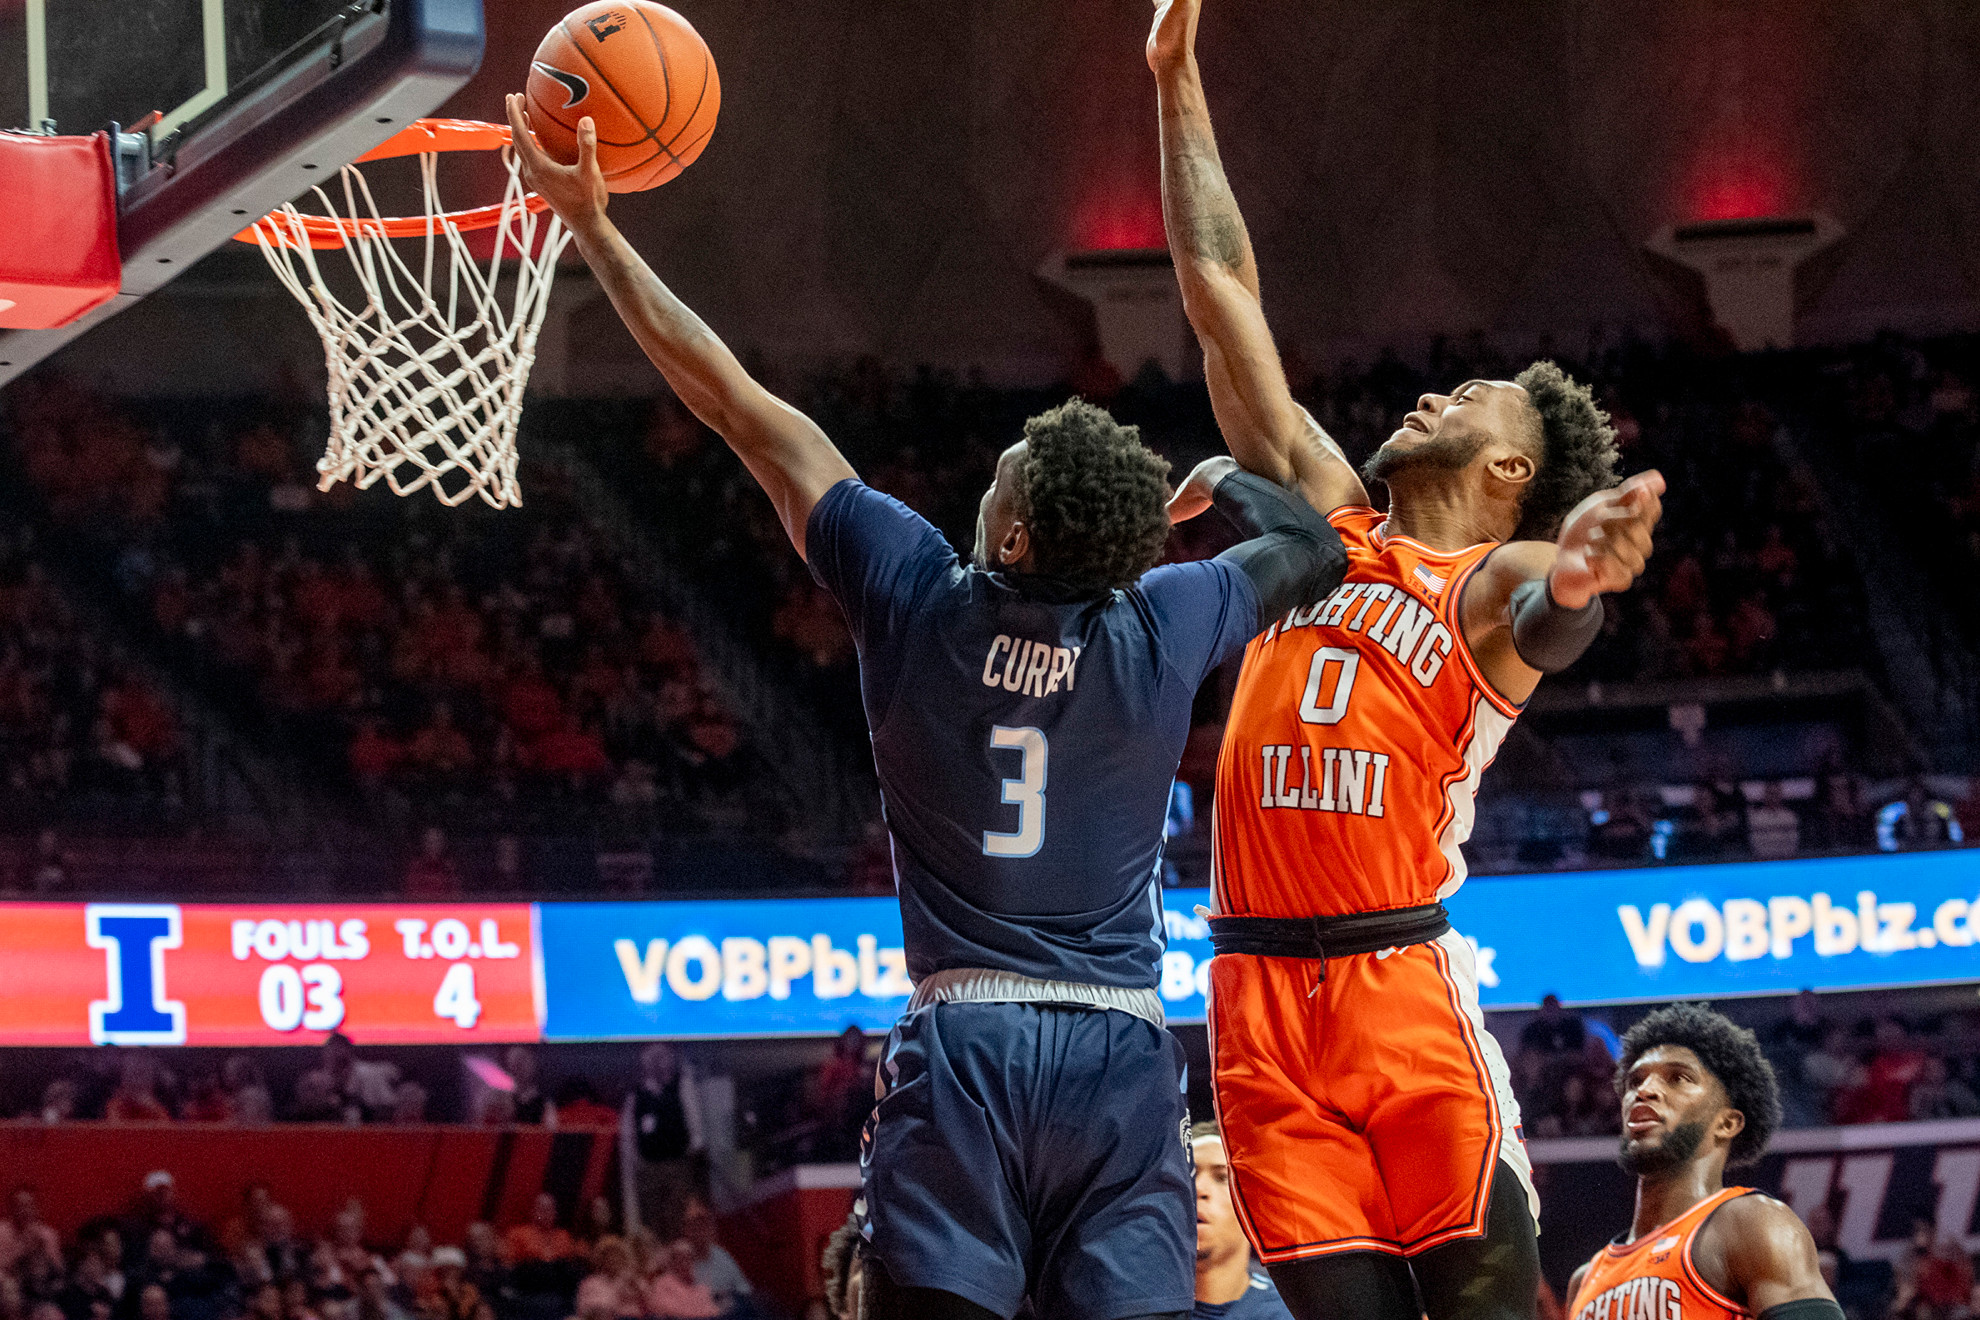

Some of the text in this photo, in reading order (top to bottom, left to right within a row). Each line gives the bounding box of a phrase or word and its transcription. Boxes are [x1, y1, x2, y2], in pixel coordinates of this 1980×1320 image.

[1298, 645, 1361, 725] 0
[982, 724, 1049, 858] 3
[1260, 744, 1390, 818] ILLINI
[231, 918, 520, 960] FOULS T.O.L.
[259, 962, 481, 1031] 03 4
